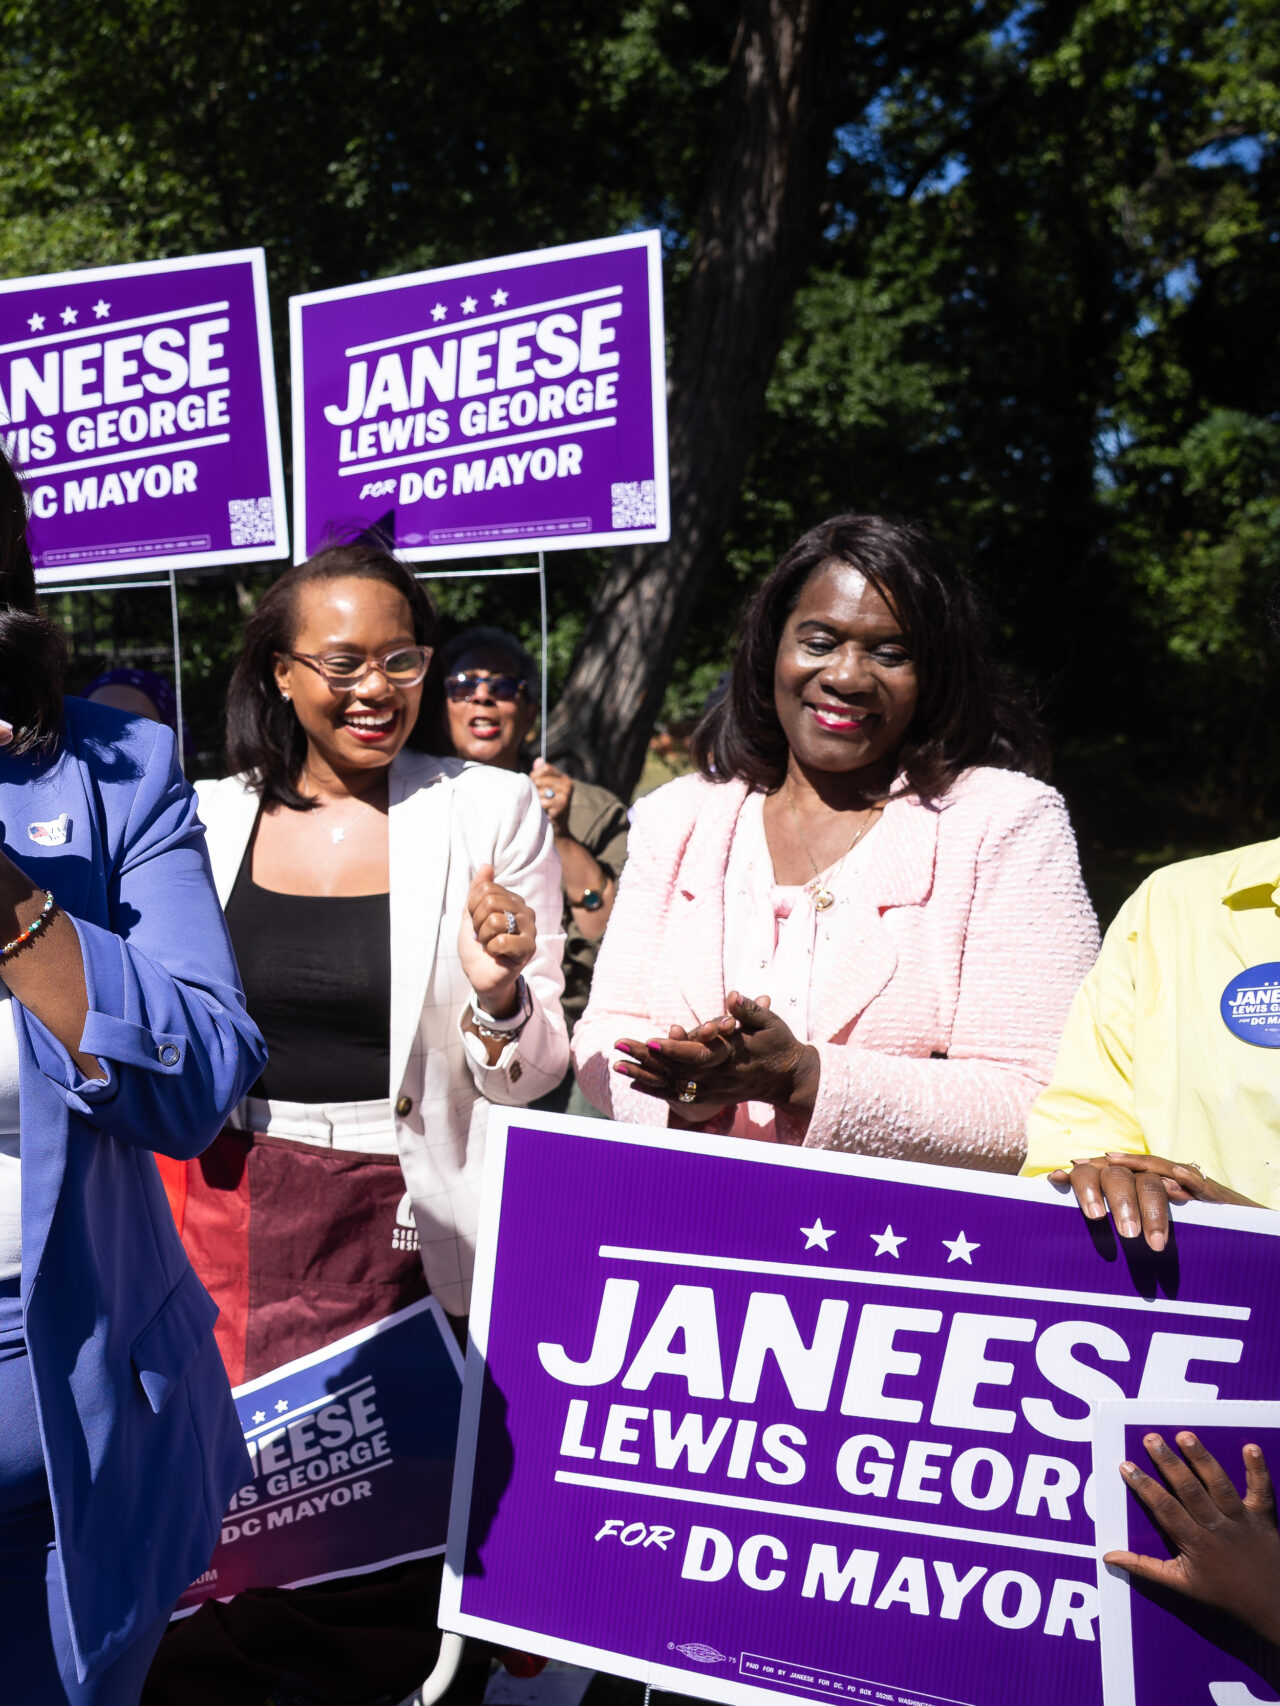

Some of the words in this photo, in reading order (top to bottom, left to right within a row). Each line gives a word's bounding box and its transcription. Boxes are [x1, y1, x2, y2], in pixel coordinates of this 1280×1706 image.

[323, 302, 623, 427] JANEESE
[66, 389, 230, 454] GEORGE
[339, 408, 450, 463] LEWIS
[459, 372, 619, 437] GEORGE
[64, 460, 199, 515] MAYOR
[359, 479, 397, 500] FOR
[398, 468, 448, 505] DC
[452, 443, 583, 496] MAYOR
[1228, 989, 1280, 1006] JANE
[1232, 1004, 1268, 1015] LEWIS
[1250, 1016, 1266, 1026] DC
[391, 1238, 422, 1251] DESI
[392, 1228, 419, 1241] SIE
[267, 1431, 391, 1497] GEORGE
[559, 1399, 809, 1487] LEWIS
[835, 1432, 1101, 1522] GEOR
[221, 1515, 262, 1545] DC
[266, 1480, 372, 1531] MAYOR
[594, 1518, 677, 1552] FOR
[680, 1524, 788, 1592] DC
[801, 1542, 1100, 1643] MAYOR
[745, 1661, 759, 1671] PAID
[762, 1665, 774, 1674] FOR
[777, 1668, 786, 1676] BY
[789, 1671, 815, 1683] JANEESE
[818, 1678, 830, 1687] FOR
[859, 1687, 872, 1696] BOX
